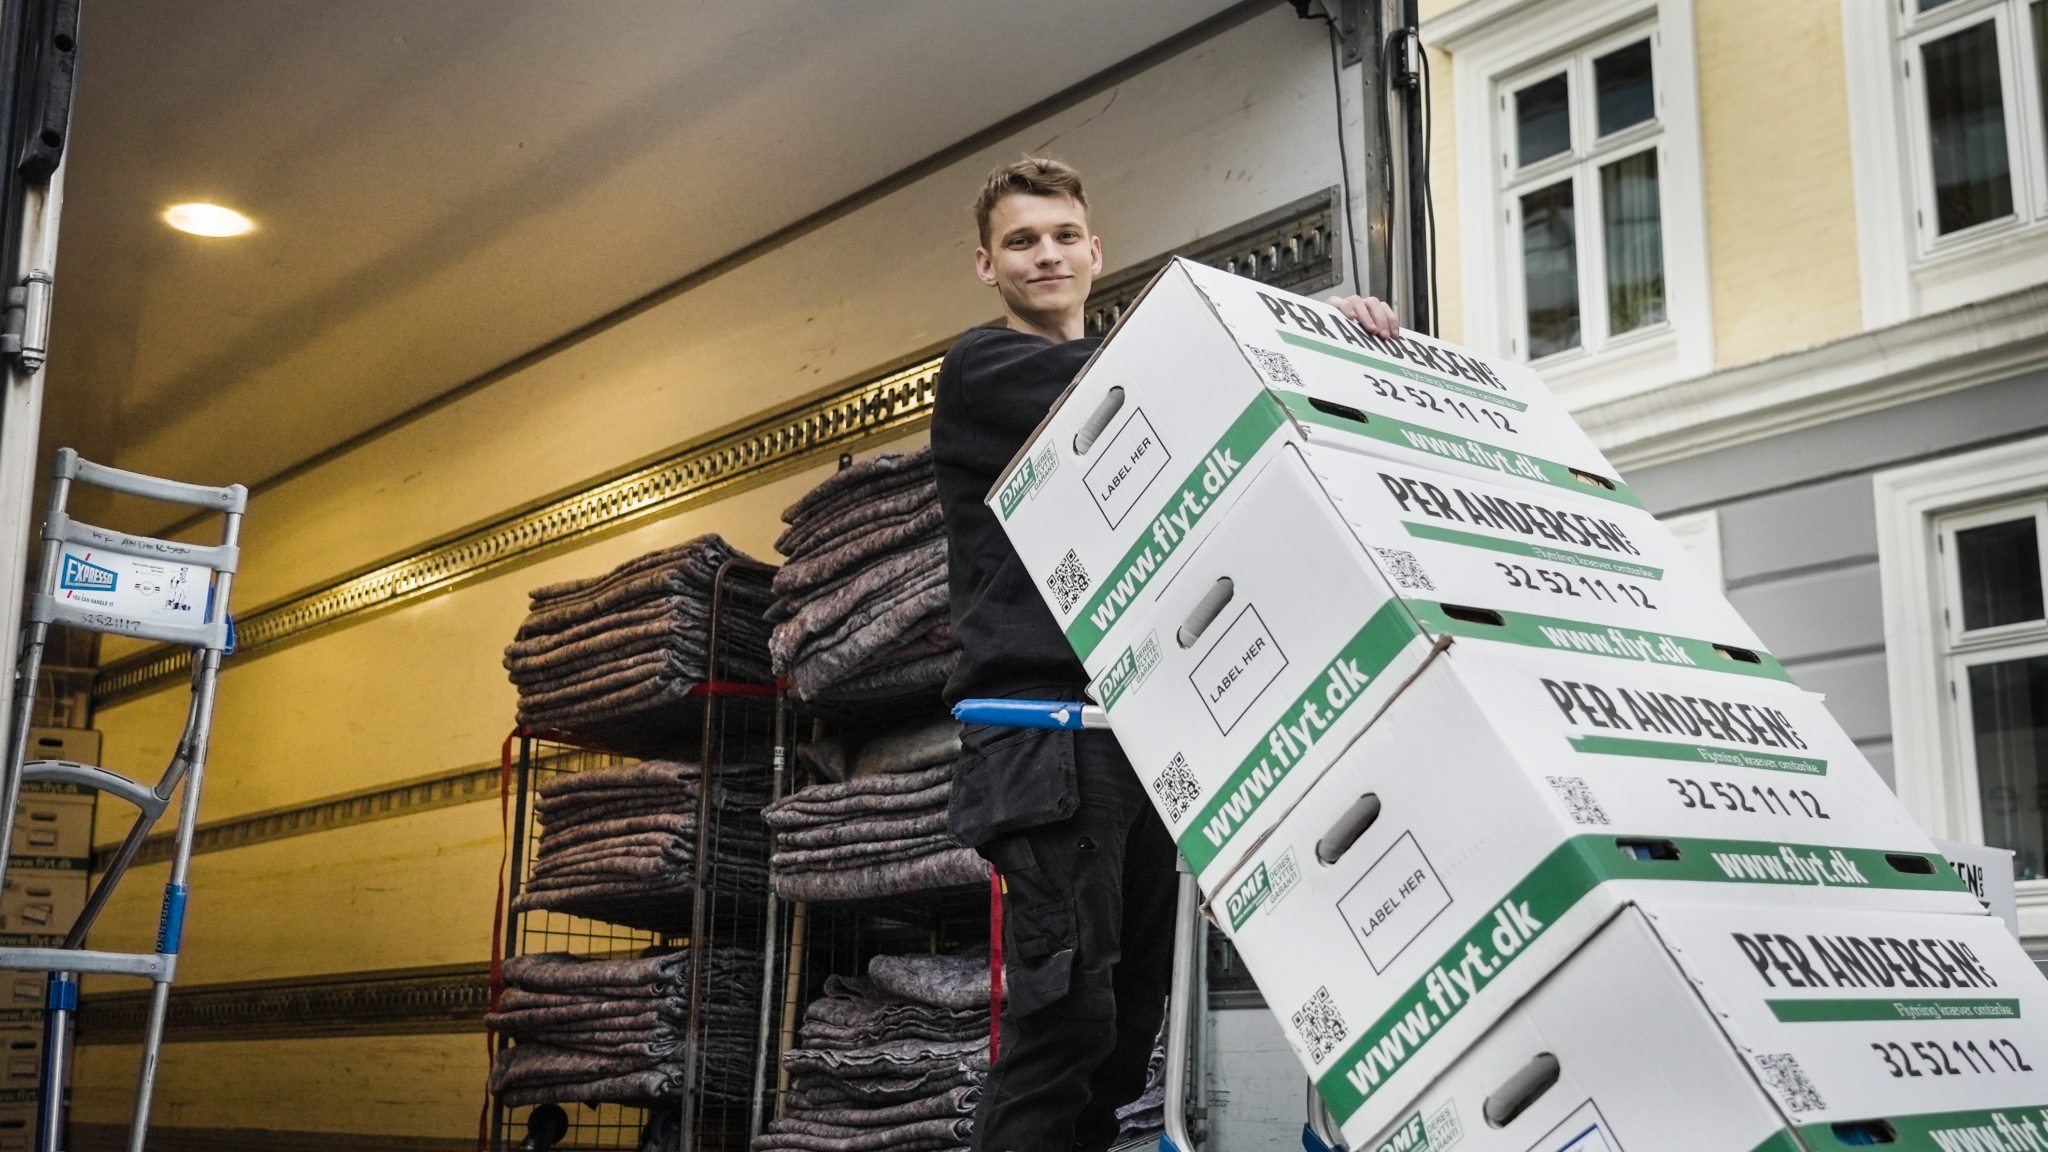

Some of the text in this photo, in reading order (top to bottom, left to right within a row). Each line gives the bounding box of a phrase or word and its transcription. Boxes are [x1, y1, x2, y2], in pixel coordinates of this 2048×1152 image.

[1256, 291, 1338, 340] PER
[1364, 374, 1518, 434] 32 52 11 12
[1034, 448, 1051, 472] DERES
[1034, 460, 1057, 491] GARANTI
[1036, 453, 1056, 479] FLYTTE-
[1101, 437, 1152, 501] LABEL HER
[1400, 429, 1549, 482] www.flyt.dk
[1001, 460, 1030, 508] DMF
[1377, 472, 1464, 522] PER
[1453, 488, 1633, 555] ANDERSEN
[1090, 447, 1241, 632] www.flyt.dk
[65, 558, 113, 586] EXPRESSO
[1494, 562, 1657, 610] 32 52 11 12
[90, 598, 108, 607] HANDLE
[1135, 637, 1153, 663] DERES
[1138, 644, 1158, 670] FLYTTE-
[1538, 626, 1697, 666] www.flyt.dk
[1101, 650, 1131, 699] DMF
[1136, 652, 1160, 683] GARANTI
[1210, 637, 1266, 704] LABEL HER
[1539, 678, 1633, 730] PER
[1617, 687, 1799, 750] ANDERSEN
[1202, 657, 1370, 848] www.flyt.dk
[1667, 778, 1830, 819] 32 52 11 12
[1269, 854, 1290, 880] DERES
[1272, 862, 1296, 890] FLYTTE-
[1710, 846, 1869, 886] www.flyt.dk
[1228, 865, 1264, 917] DMF
[1269, 871, 1298, 904] GARANTI
[1361, 868, 1426, 937] LABEL HER
[157, 885, 172, 951] EXPRESSO
[1730, 933, 1830, 988] PER
[1806, 935, 1991, 989] ANDERSEN
[1346, 898, 1544, 1096] www.flyt.dk
[1973, 1002, 2014, 1016] omtanke
[1870, 1038, 2034, 1077] 32 52 11 12
[1426, 1107, 1451, 1134] DERES
[1429, 1116, 1457, 1143] FLYTTE-
